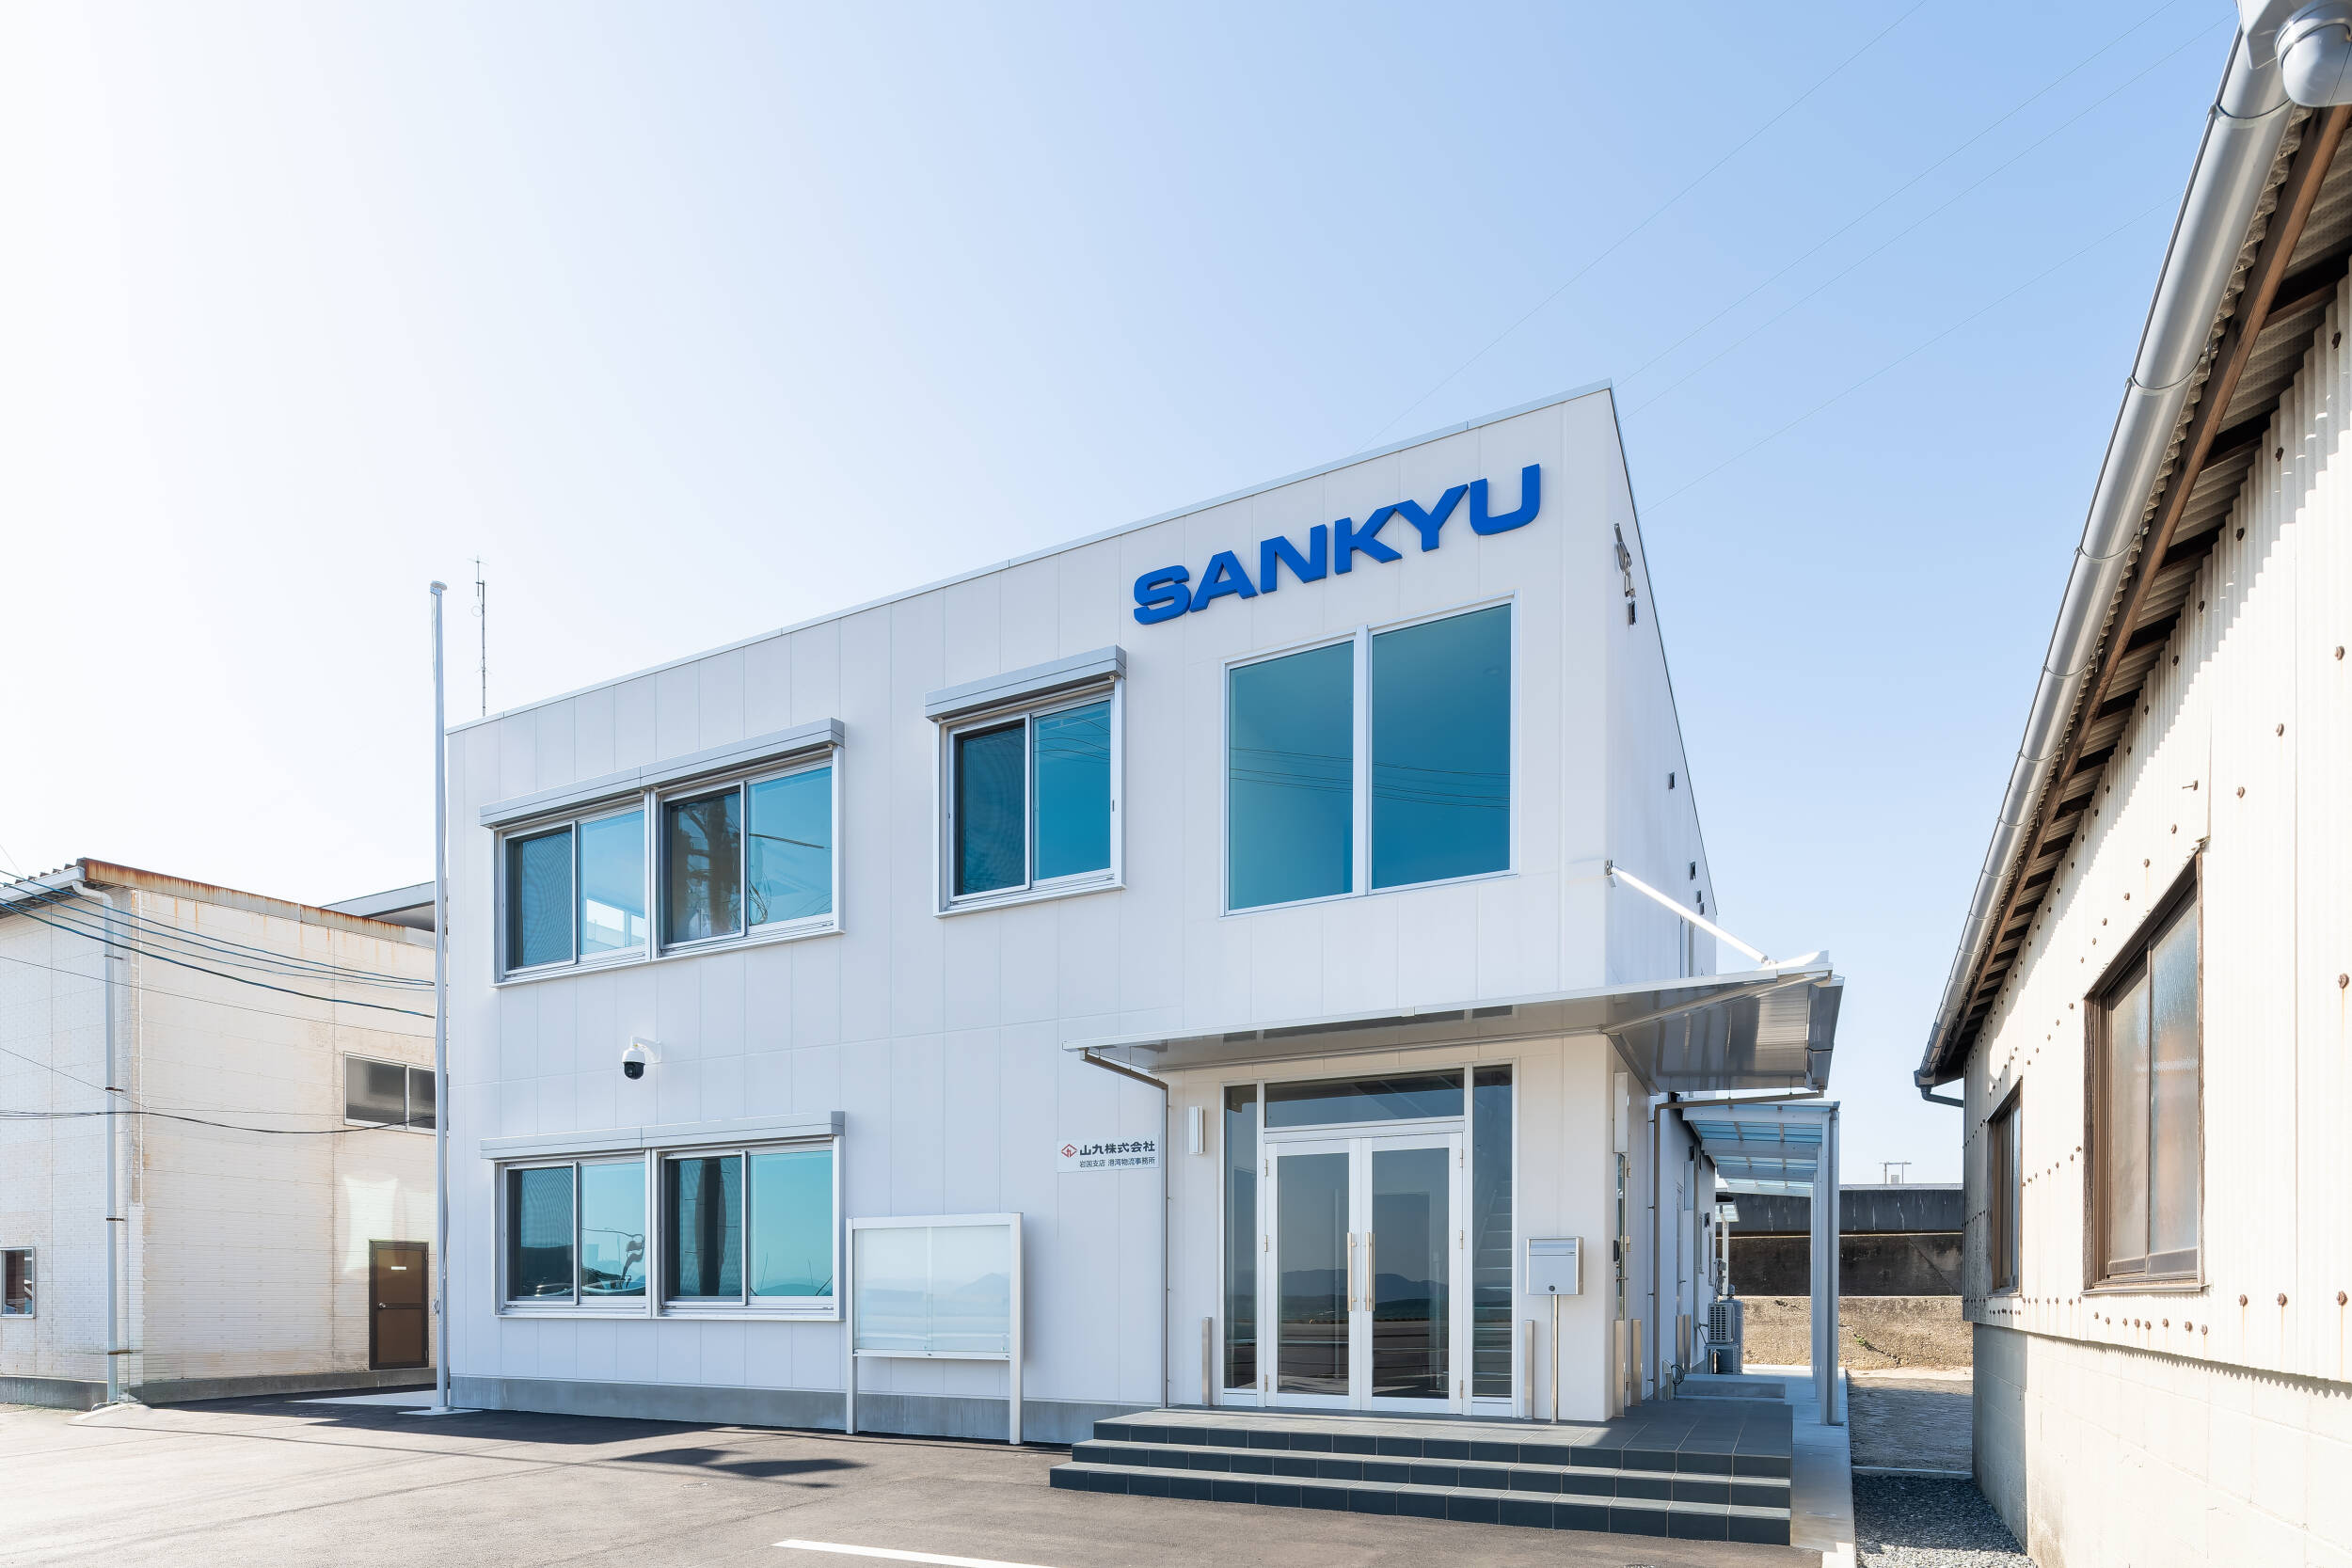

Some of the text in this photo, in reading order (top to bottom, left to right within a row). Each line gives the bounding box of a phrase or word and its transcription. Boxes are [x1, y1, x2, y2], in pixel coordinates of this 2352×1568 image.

[1133, 463, 1541, 626] SANKYU
[1079, 1141, 1155, 1156] 山九株式会社
